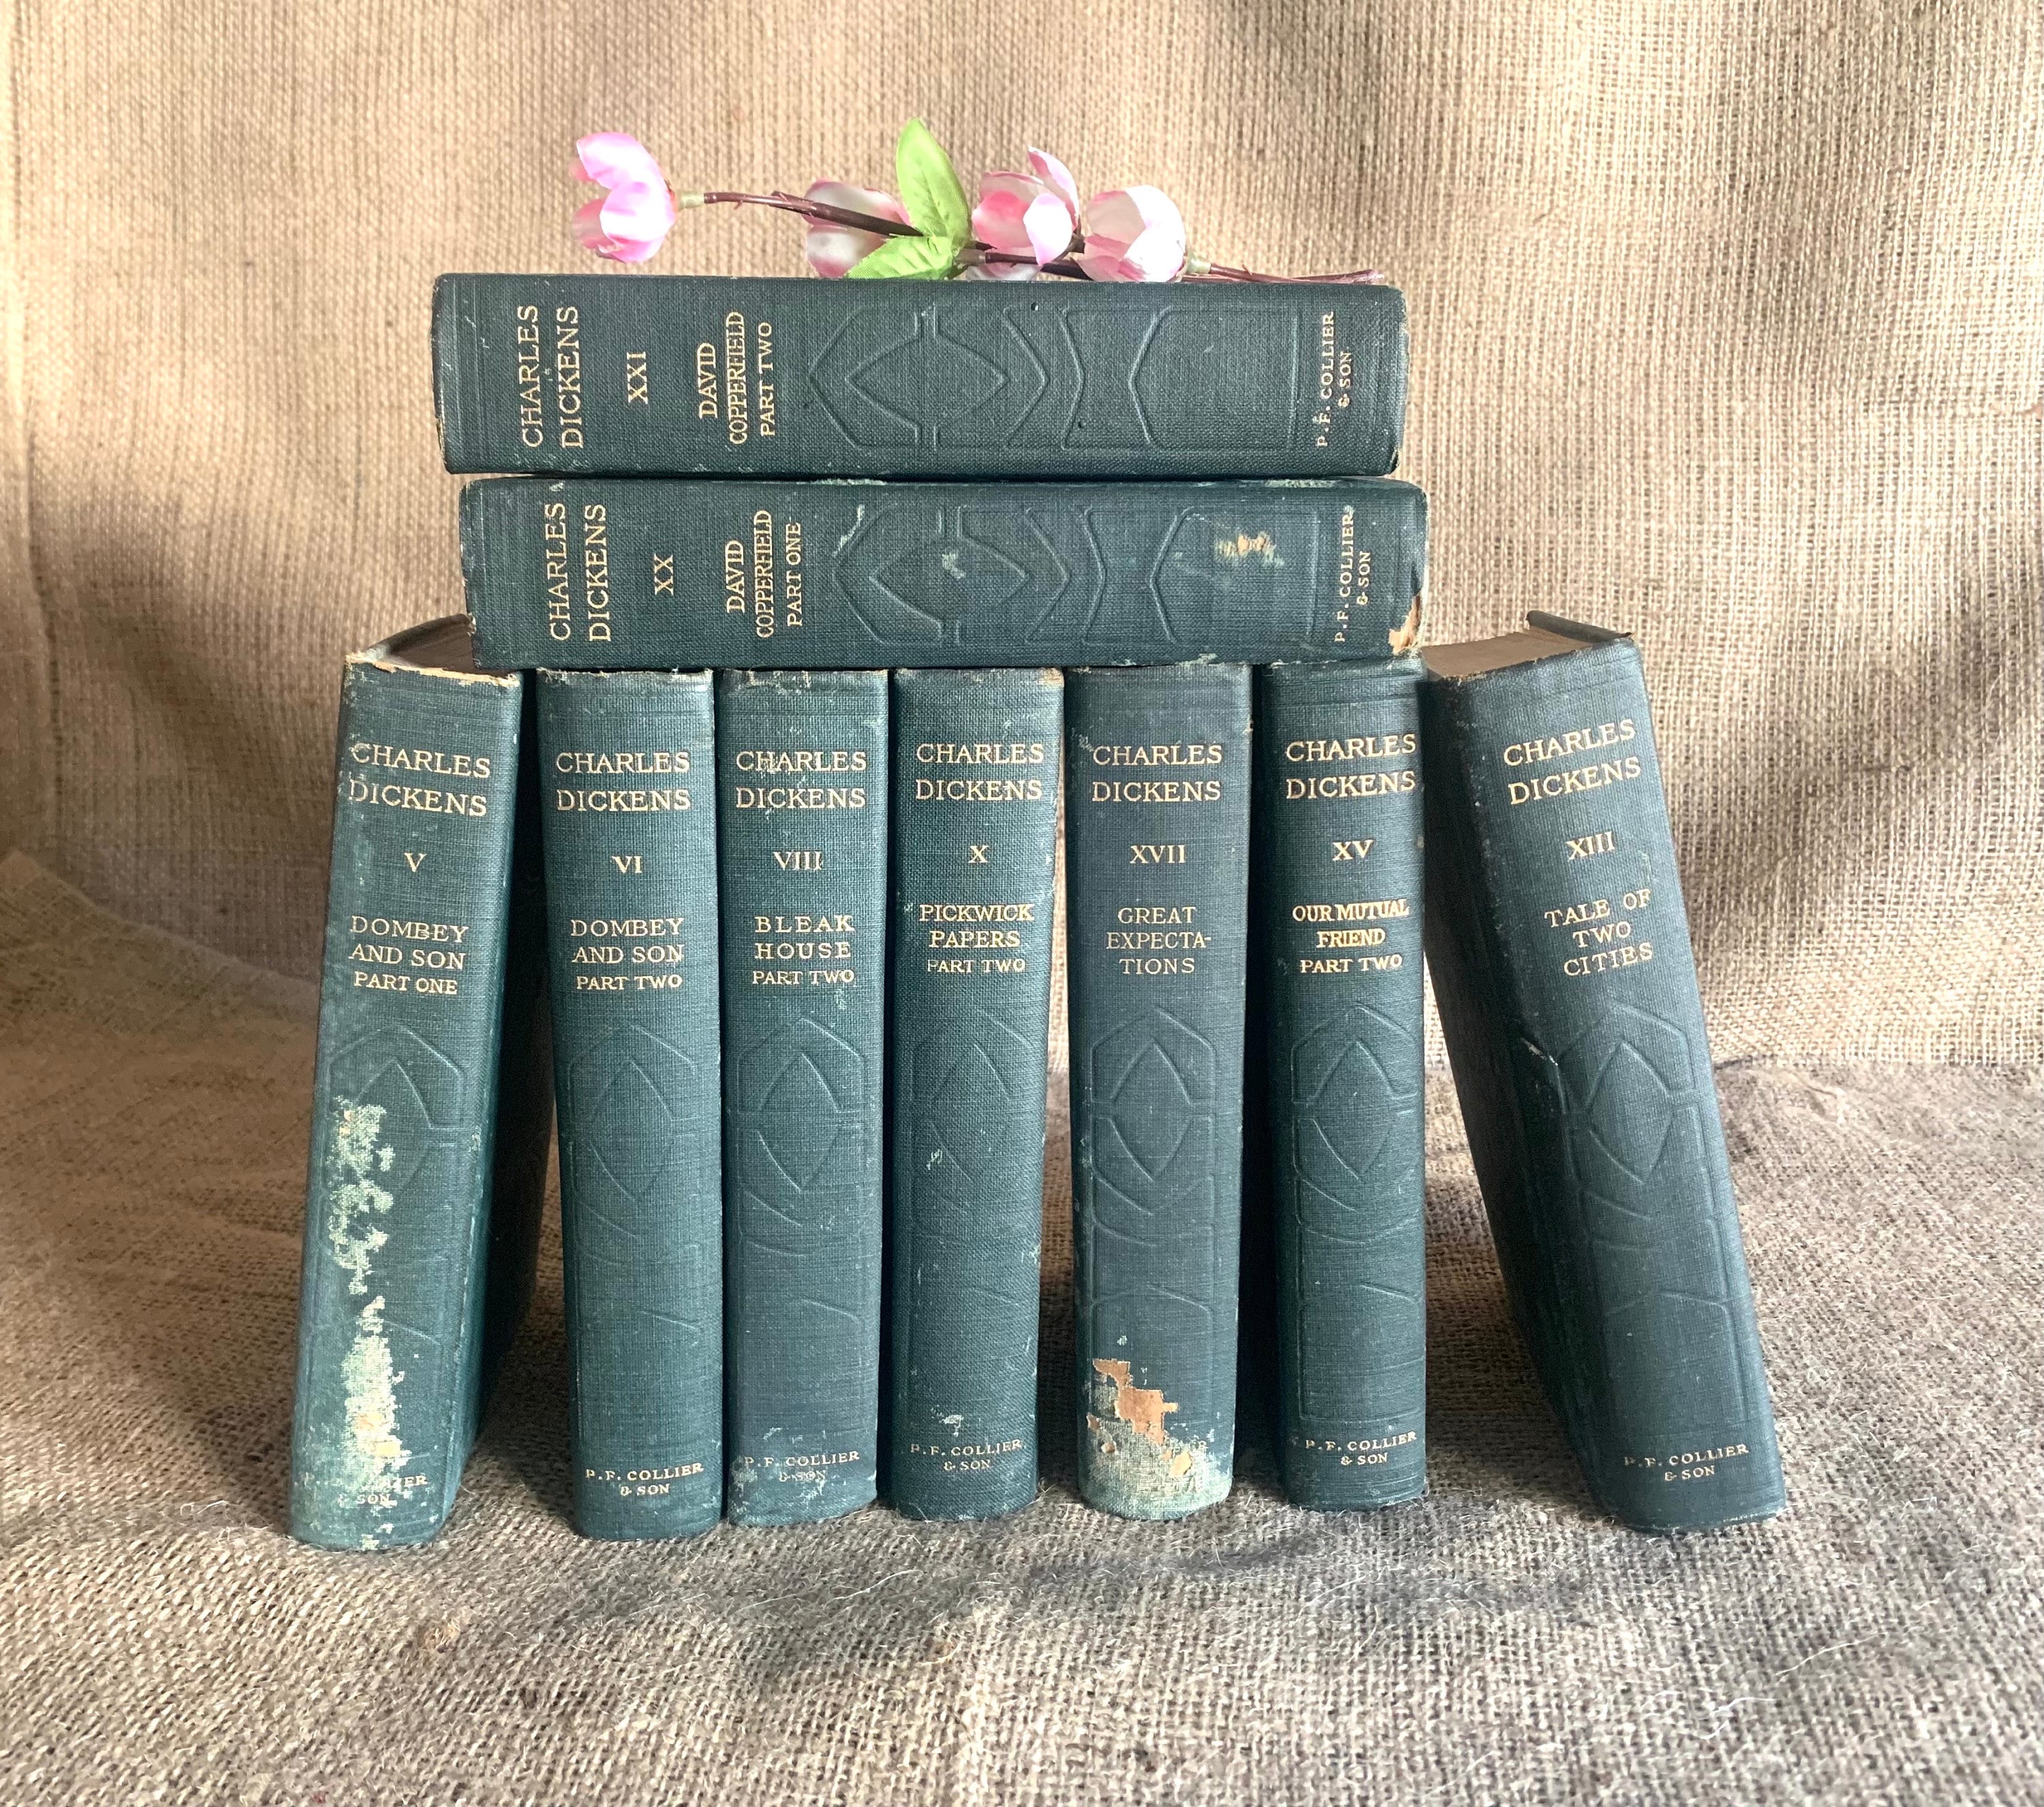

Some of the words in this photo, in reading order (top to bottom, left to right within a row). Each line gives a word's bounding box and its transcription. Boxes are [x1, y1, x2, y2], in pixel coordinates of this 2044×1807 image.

[758, 322, 773, 374] TWO
[1320, 311, 1333, 399] COLLIER
[518, 305, 542, 447] CHARLES
[557, 305, 583, 448] DICKENS
[626, 351, 647, 403] XXI
[697, 342, 717, 418] DAVID
[726, 311, 747, 444] COPPERFIELD
[1340, 352, 1350, 388] SON
[760, 380, 775, 436] PART
[1337, 394, 1349, 407] &
[786, 522, 801, 564] ONE
[1340, 512, 1354, 597] COLLIER
[545, 502, 570, 640] CHARLES
[585, 504, 610, 640] DICKENS
[653, 554, 673, 594] XX
[725, 540, 744, 613] DAVID
[754, 510, 773, 637] COPPERFIELD
[1358, 551, 1370, 587] SON
[788, 571, 803, 626] PART
[1357, 591, 1367, 604] &
[916, 743, 1044, 763] CHARLES
[1286, 733, 1416, 761] CHARLES
[1504, 719, 1636, 766] CHARLES
[350, 743, 490, 778] CHARLES
[556, 752, 691, 773] CHARLES
[736, 750, 867, 772] CHARLES
[1092, 744, 1222, 764] CHARLES
[915, 779, 1042, 801] DICKENS
[1091, 781, 1220, 801] DICKENS
[1286, 769, 1416, 799] DICKENS
[1508, 756, 1641, 805] DICKENS
[349, 779, 486, 816] DICKENS
[557, 790, 692, 811] DICKENS
[737, 787, 866, 809] DICKENS
[967, 844, 989, 863] X
[1130, 845, 1186, 863] XVII
[1332, 839, 1373, 861] XV
[1566, 831, 1615, 859] XIII
[404, 852, 427, 871] V
[611, 856, 642, 874] VI
[773, 851, 822, 870] VIII
[918, 903, 1034, 921] PICKWICK
[1117, 906, 1195, 923] GREAT
[1292, 904, 1334, 921] OUR
[1336, 899, 1409, 921] MUTUAL
[1544, 899, 1610, 927] TALE
[1623, 888, 1650, 909] OF
[351, 916, 469, 943] DOMBEY
[570, 917, 684, 936] DOMBEY
[754, 915, 855, 933] BLEAK
[1573, 921, 1630, 947] TWO
[929, 930, 1020, 947] PAPERS
[1106, 932, 1211, 949] EXPECTA-
[1316, 928, 1385, 948] FRIEND
[347, 944, 402, 964] AND
[411, 951, 466, 970] SON
[572, 946, 623, 963] AND
[632, 944, 685, 963] SON
[754, 942, 851, 959] HOUSE
[1564, 942, 1653, 976] CITIES
[927, 960, 974, 972] PART
[981, 958, 1025, 972] TWO
[1119, 957, 1194, 974] TIONS
[1300, 958, 1352, 972] PART
[1359, 955, 1402, 970] TWO
[354, 971, 410, 991] PART
[416, 977, 457, 995] ONE
[576, 976, 628, 990] PART
[634, 974, 682, 989] TWO
[752, 970, 803, 984] PART
[809, 969, 854, 984] TWO
[950, 1439, 1021, 1455] COLLIER
[1347, 1431, 1416, 1451] COLLIER
[786, 1450, 860, 1466] COLLIER
[943, 1461, 955, 1470] &
[959, 1459, 990, 1470] SON
[1341, 1455, 1352, 1464] &
[1357, 1453, 1388, 1464] SON
[1669, 1443, 1749, 1466] COLLIER
[627, 1462, 704, 1481] COLLIER
[792, 1470, 826, 1481] SON
[1664, 1471, 1677, 1481] &
[1682, 1465, 1714, 1479] SON
[357, 1494, 390, 1504] SON
[620, 1486, 631, 1496] &
[636, 1483, 669, 1496] SON
